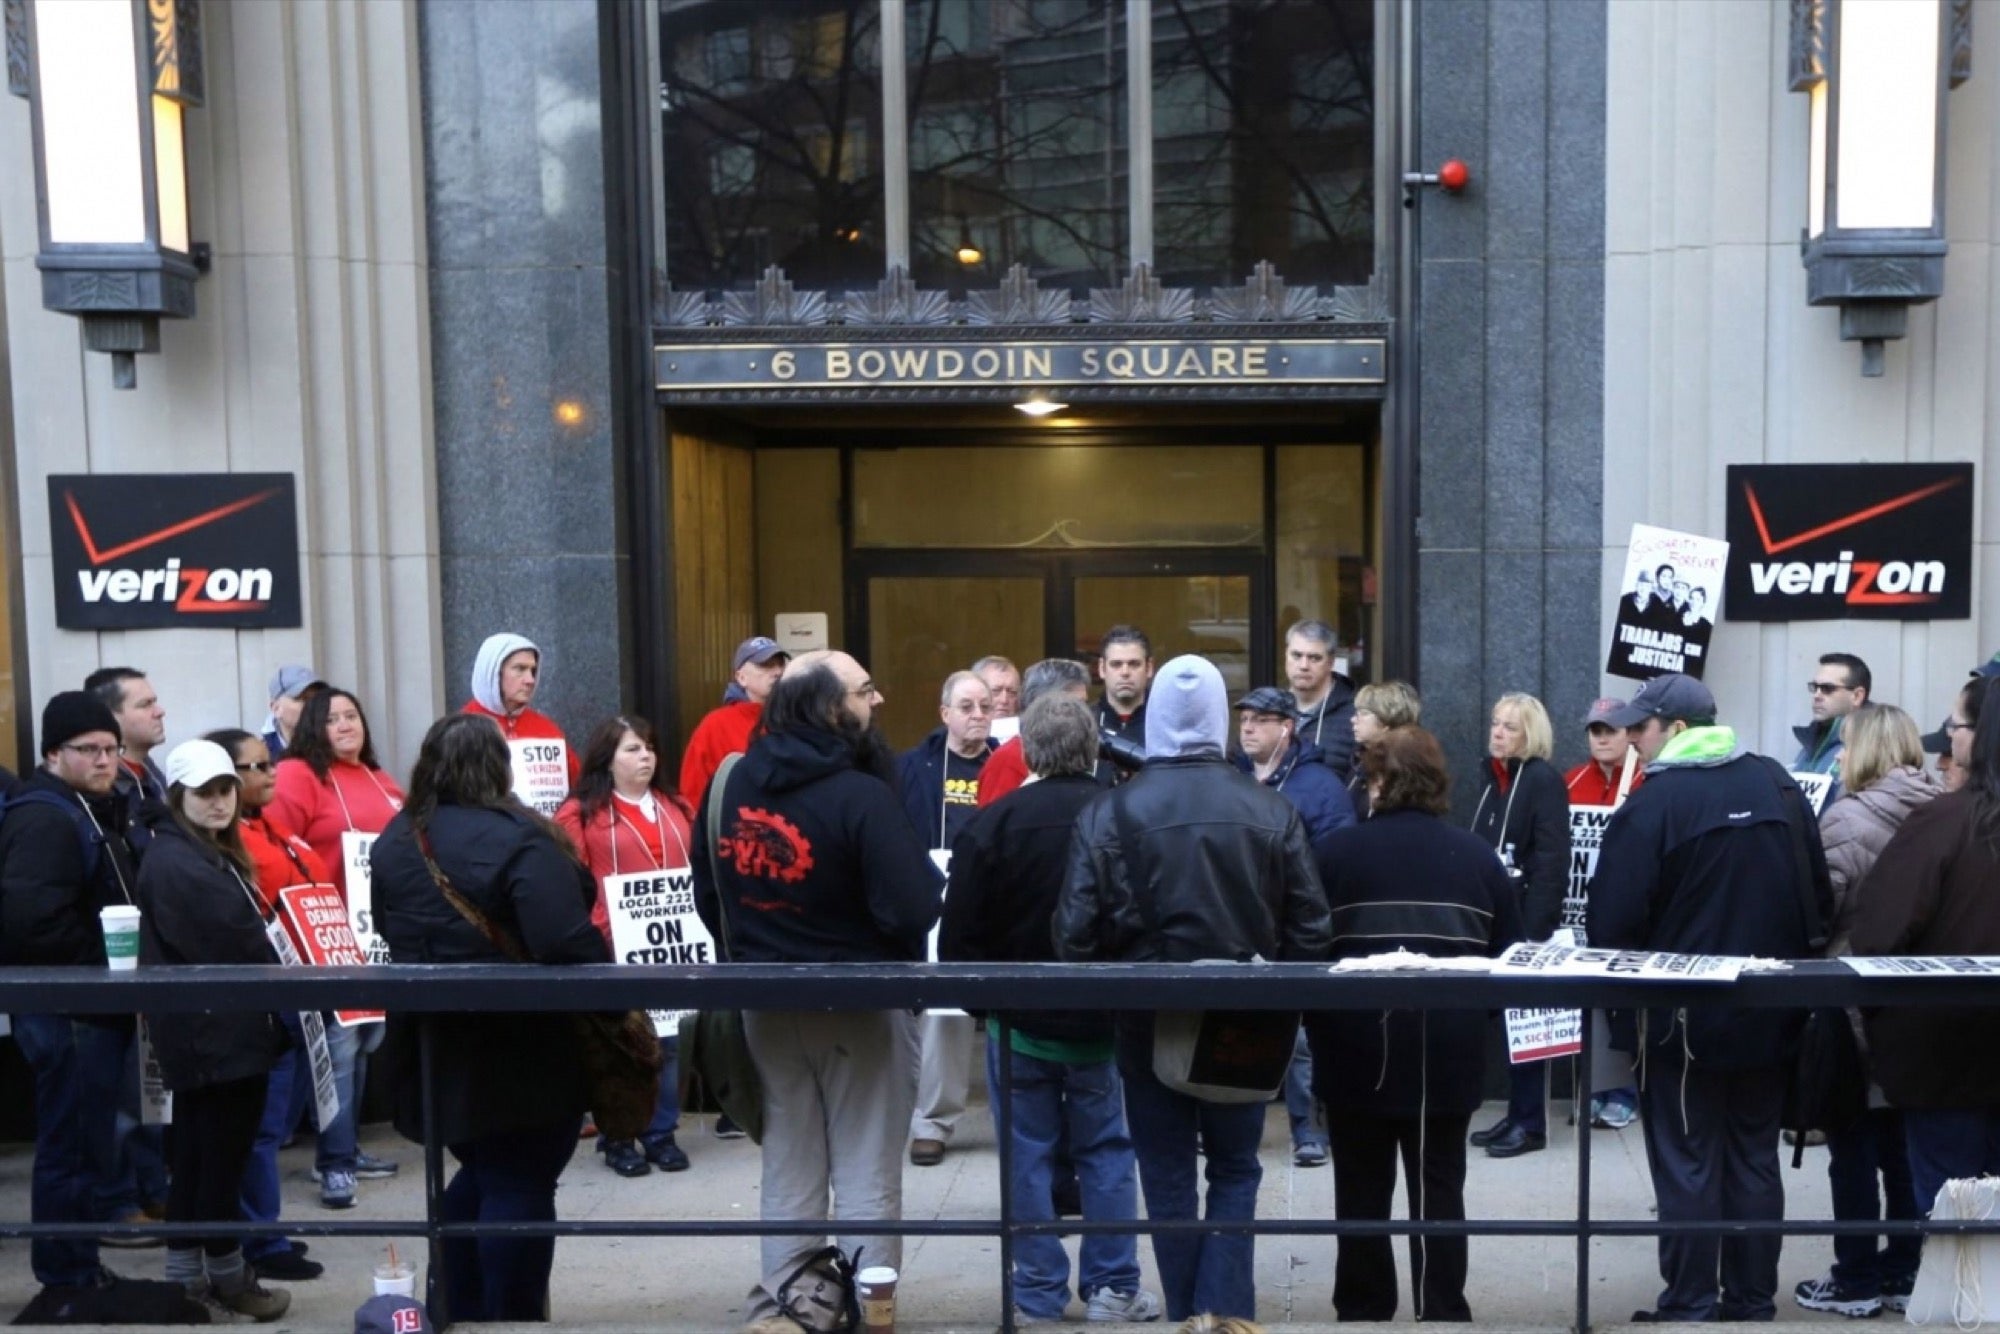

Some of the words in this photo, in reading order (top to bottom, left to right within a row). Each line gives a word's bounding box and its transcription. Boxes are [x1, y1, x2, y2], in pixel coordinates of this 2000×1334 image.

[771, 350, 796, 379] 6
[827, 348, 1051, 379] BOWDOIN
[1080, 347, 1269, 377] SQUARE
[78, 557, 273, 612] verizon
[1750, 550, 1946, 604] verizon
[1628, 646, 1685, 673] JUSTICIA
[523, 745, 561, 763] STOP
[623, 875, 693, 898] IBEW
[619, 898, 660, 910] LOCAL
[666, 892, 692, 905] 222
[630, 903, 695, 920] WORKERS
[315, 926, 355, 949] GOOD
[646, 919, 684, 946] ON
[626, 942, 709, 965] STRIKE
[1511, 1036, 1522, 1045] A
[1525, 1031, 1552, 1043] SICK
[392, 1307, 423, 1334] 19
